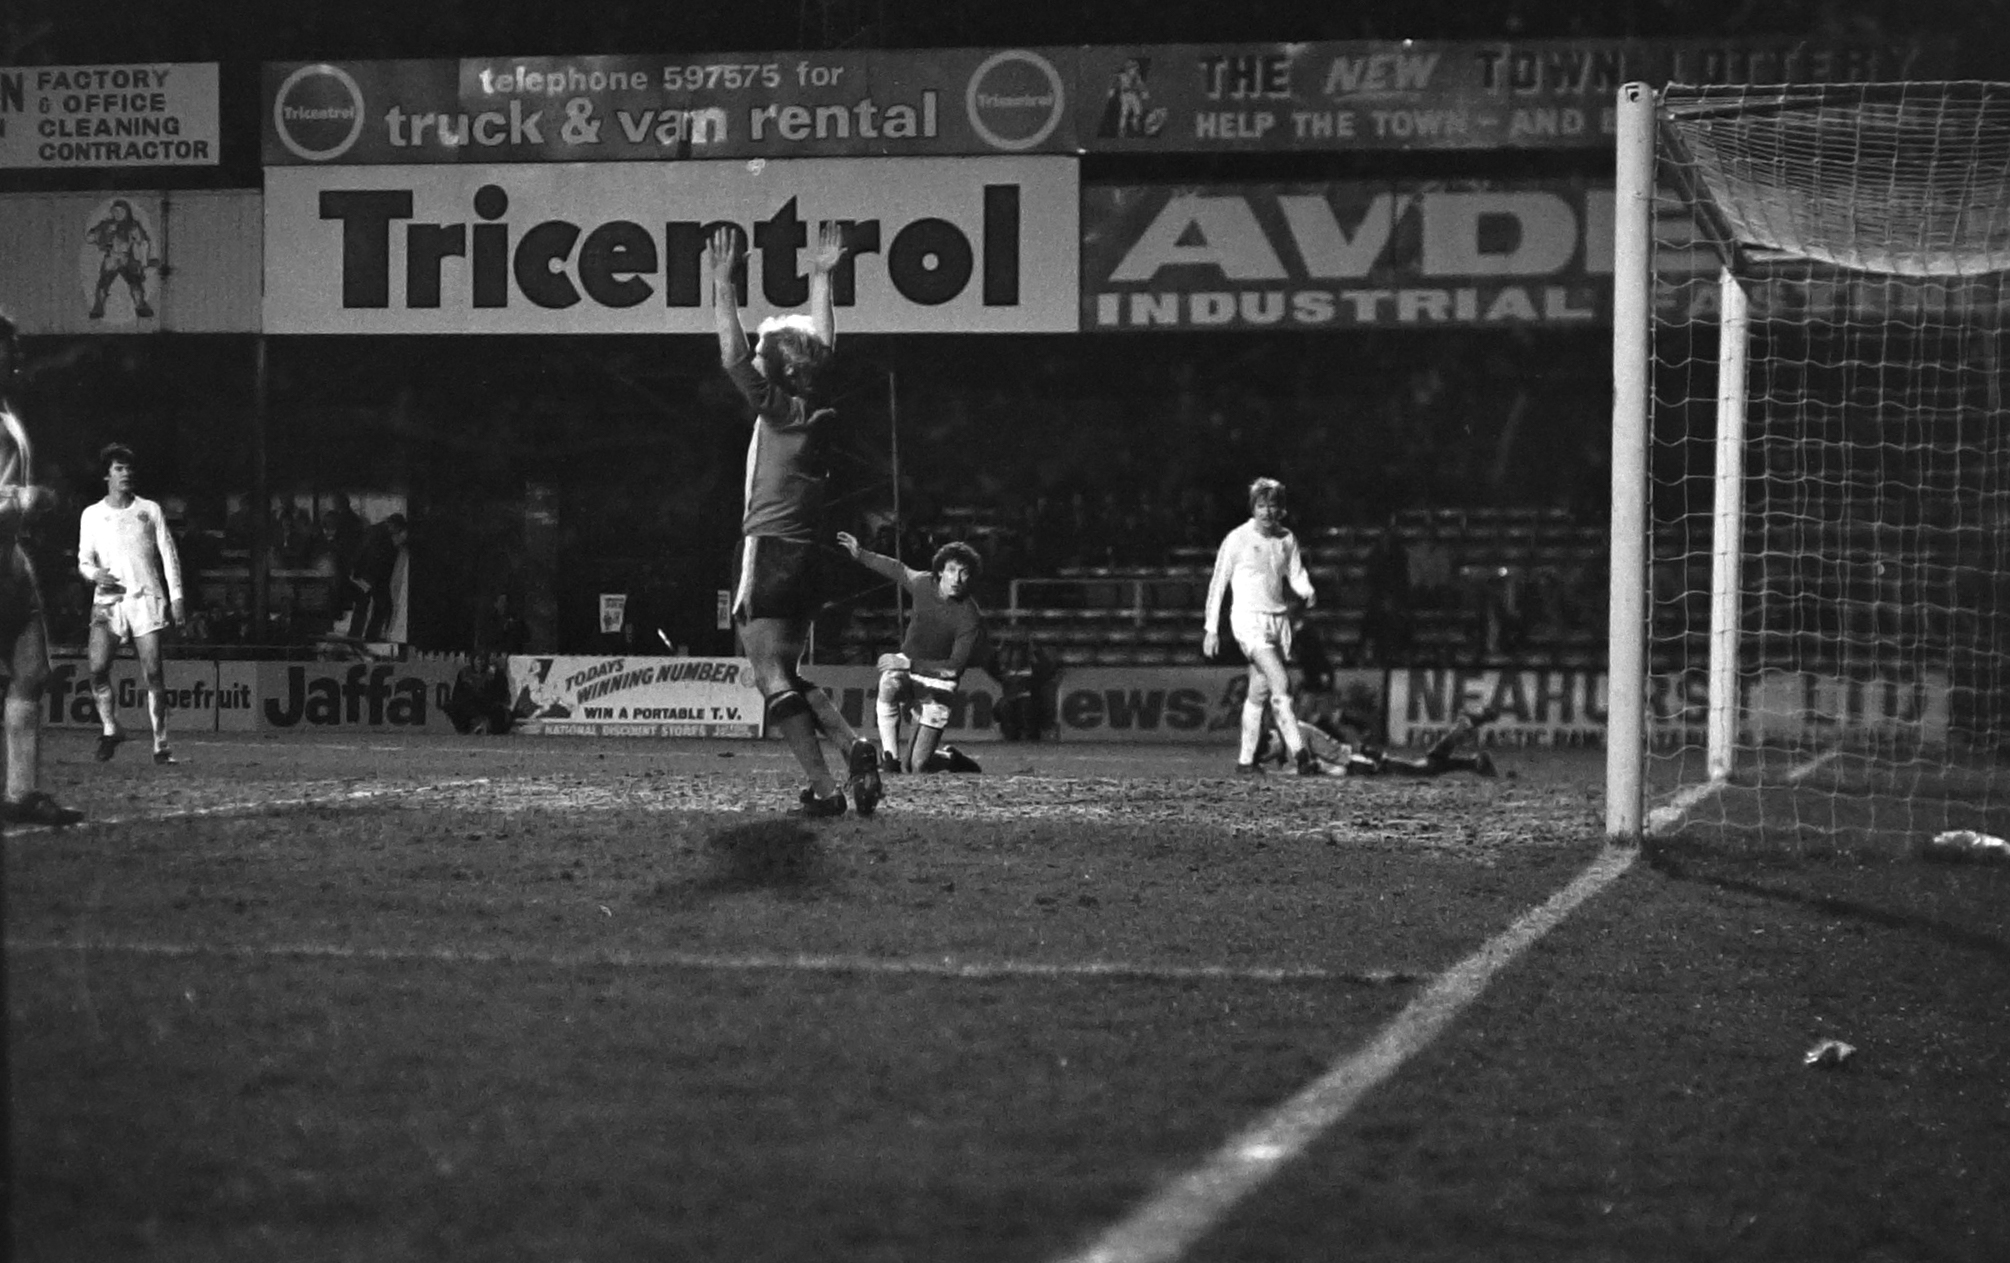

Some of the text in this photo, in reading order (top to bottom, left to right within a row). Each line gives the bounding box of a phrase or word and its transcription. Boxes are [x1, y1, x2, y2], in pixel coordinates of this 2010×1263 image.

[37, 69, 169, 91] FACTORY
[478, 60, 845, 96] telephone 597575 for
[1198, 54, 1292, 99] THE
[1323, 53, 1441, 95] NEW
[62, 93, 166, 113] OFFICE
[385, 90, 938, 147] truck & van rental
[37, 116, 181, 138] CLEANING
[1195, 110, 1277, 139] HELP
[1291, 110, 1357, 138] THE
[1371, 108, 1469, 137] TOWN
[1509, 106, 1585, 136] AND
[38, 140, 209, 161] CONTRACTOR
[318, 183, 1021, 309] Tricentrol
[1097, 286, 1593, 325] INDUSTRIAL
[118, 678, 251, 709] Grpefruit
[263, 664, 427, 727] Jaffa
[577, 662, 740, 704] WINNING NUMBER
[584, 707, 615, 720] WIN
[618, 707, 629, 720] A
[632, 707, 705, 720] PORTABLE
[544, 724, 597, 737] NATIONAL
